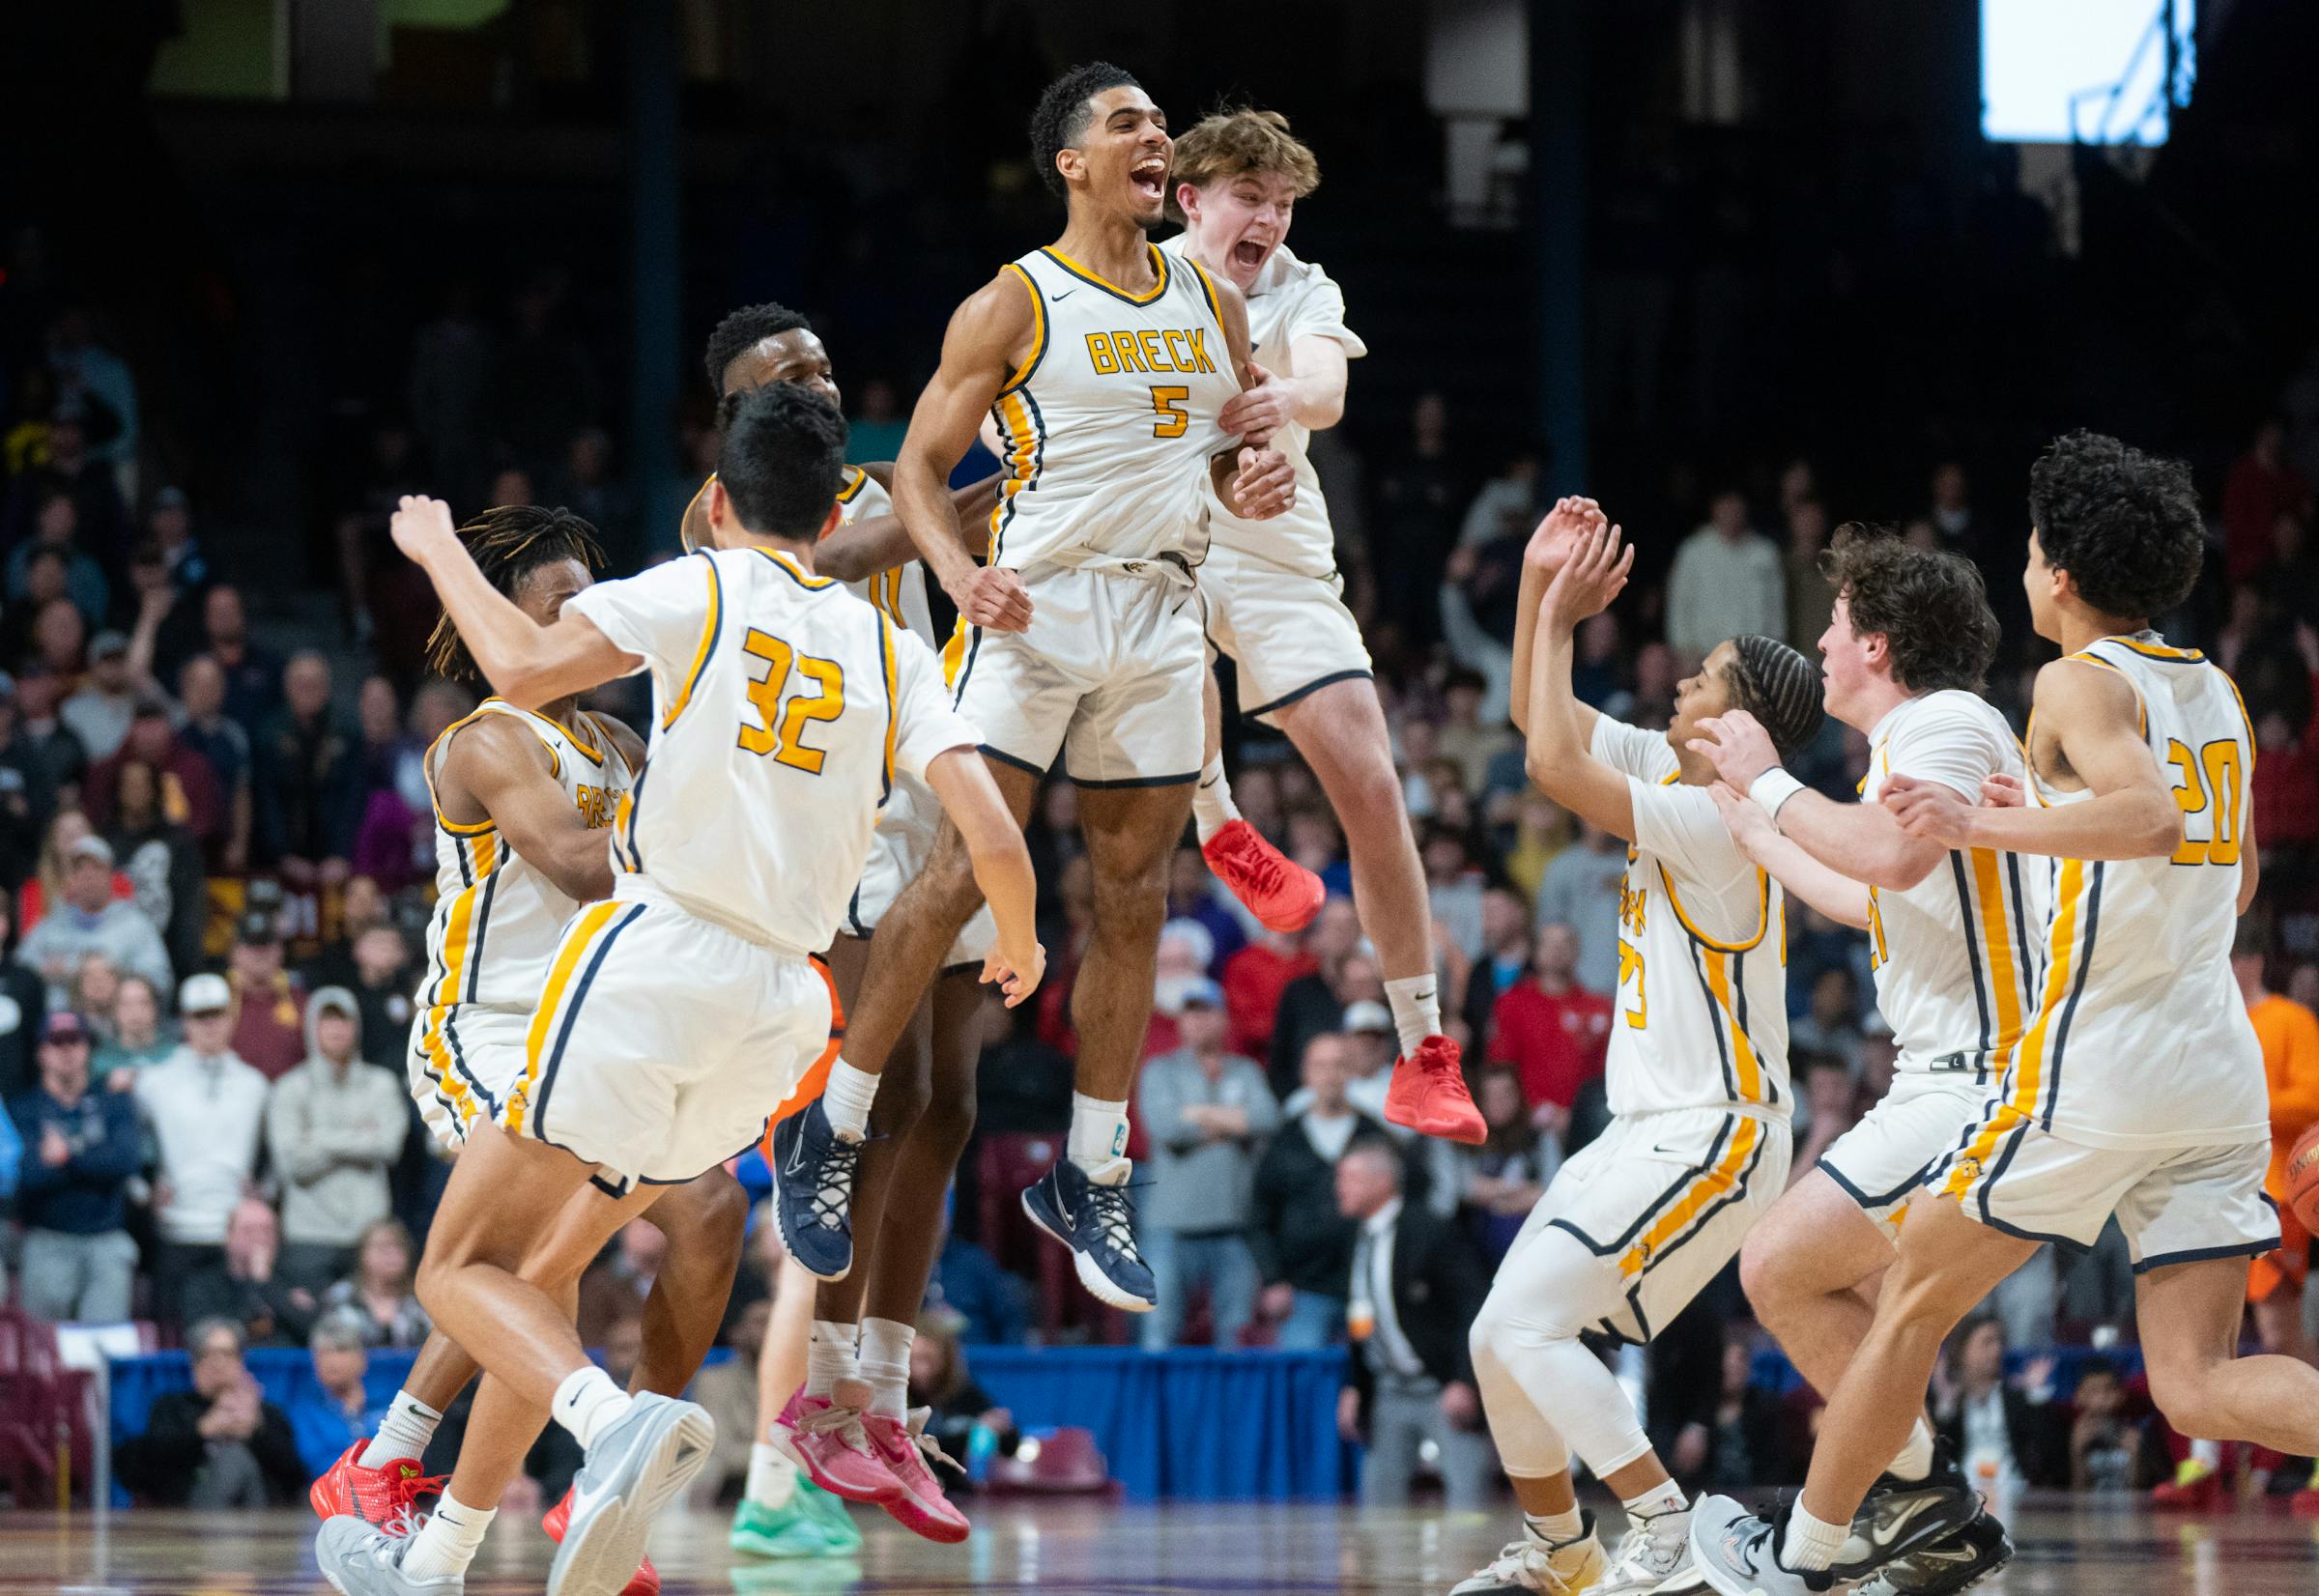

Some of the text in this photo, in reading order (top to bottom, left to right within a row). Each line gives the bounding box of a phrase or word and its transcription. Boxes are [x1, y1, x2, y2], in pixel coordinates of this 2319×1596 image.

[1084, 328, 1217, 375] BRECK
[1149, 385, 1189, 438] 5
[736, 626, 845, 776] 32
[2166, 737, 2242, 867] 20
